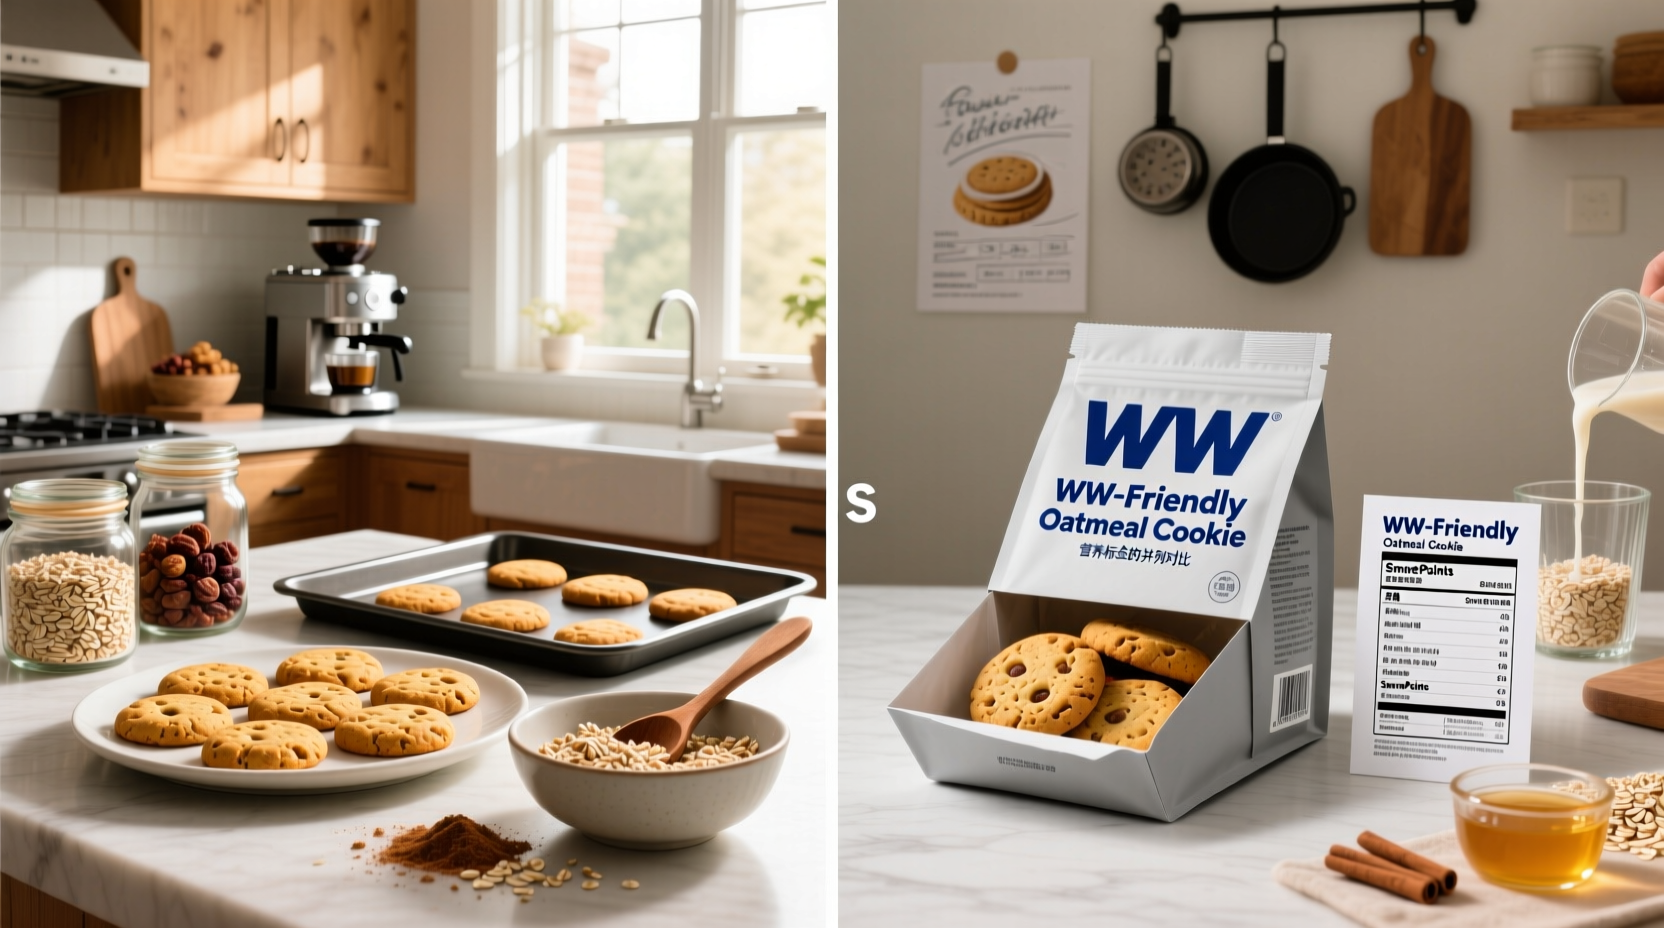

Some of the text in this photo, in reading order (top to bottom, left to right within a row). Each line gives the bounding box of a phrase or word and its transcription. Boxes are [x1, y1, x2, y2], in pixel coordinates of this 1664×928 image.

[1085, 400, 1270, 476] WW
[1056, 478, 1248, 522] WW-Friendly
[1039, 508, 1149, 539] Oatmeal
[1153, 517, 1246, 547] Cookie
[1383, 515, 1519, 545] WW-Friendly
